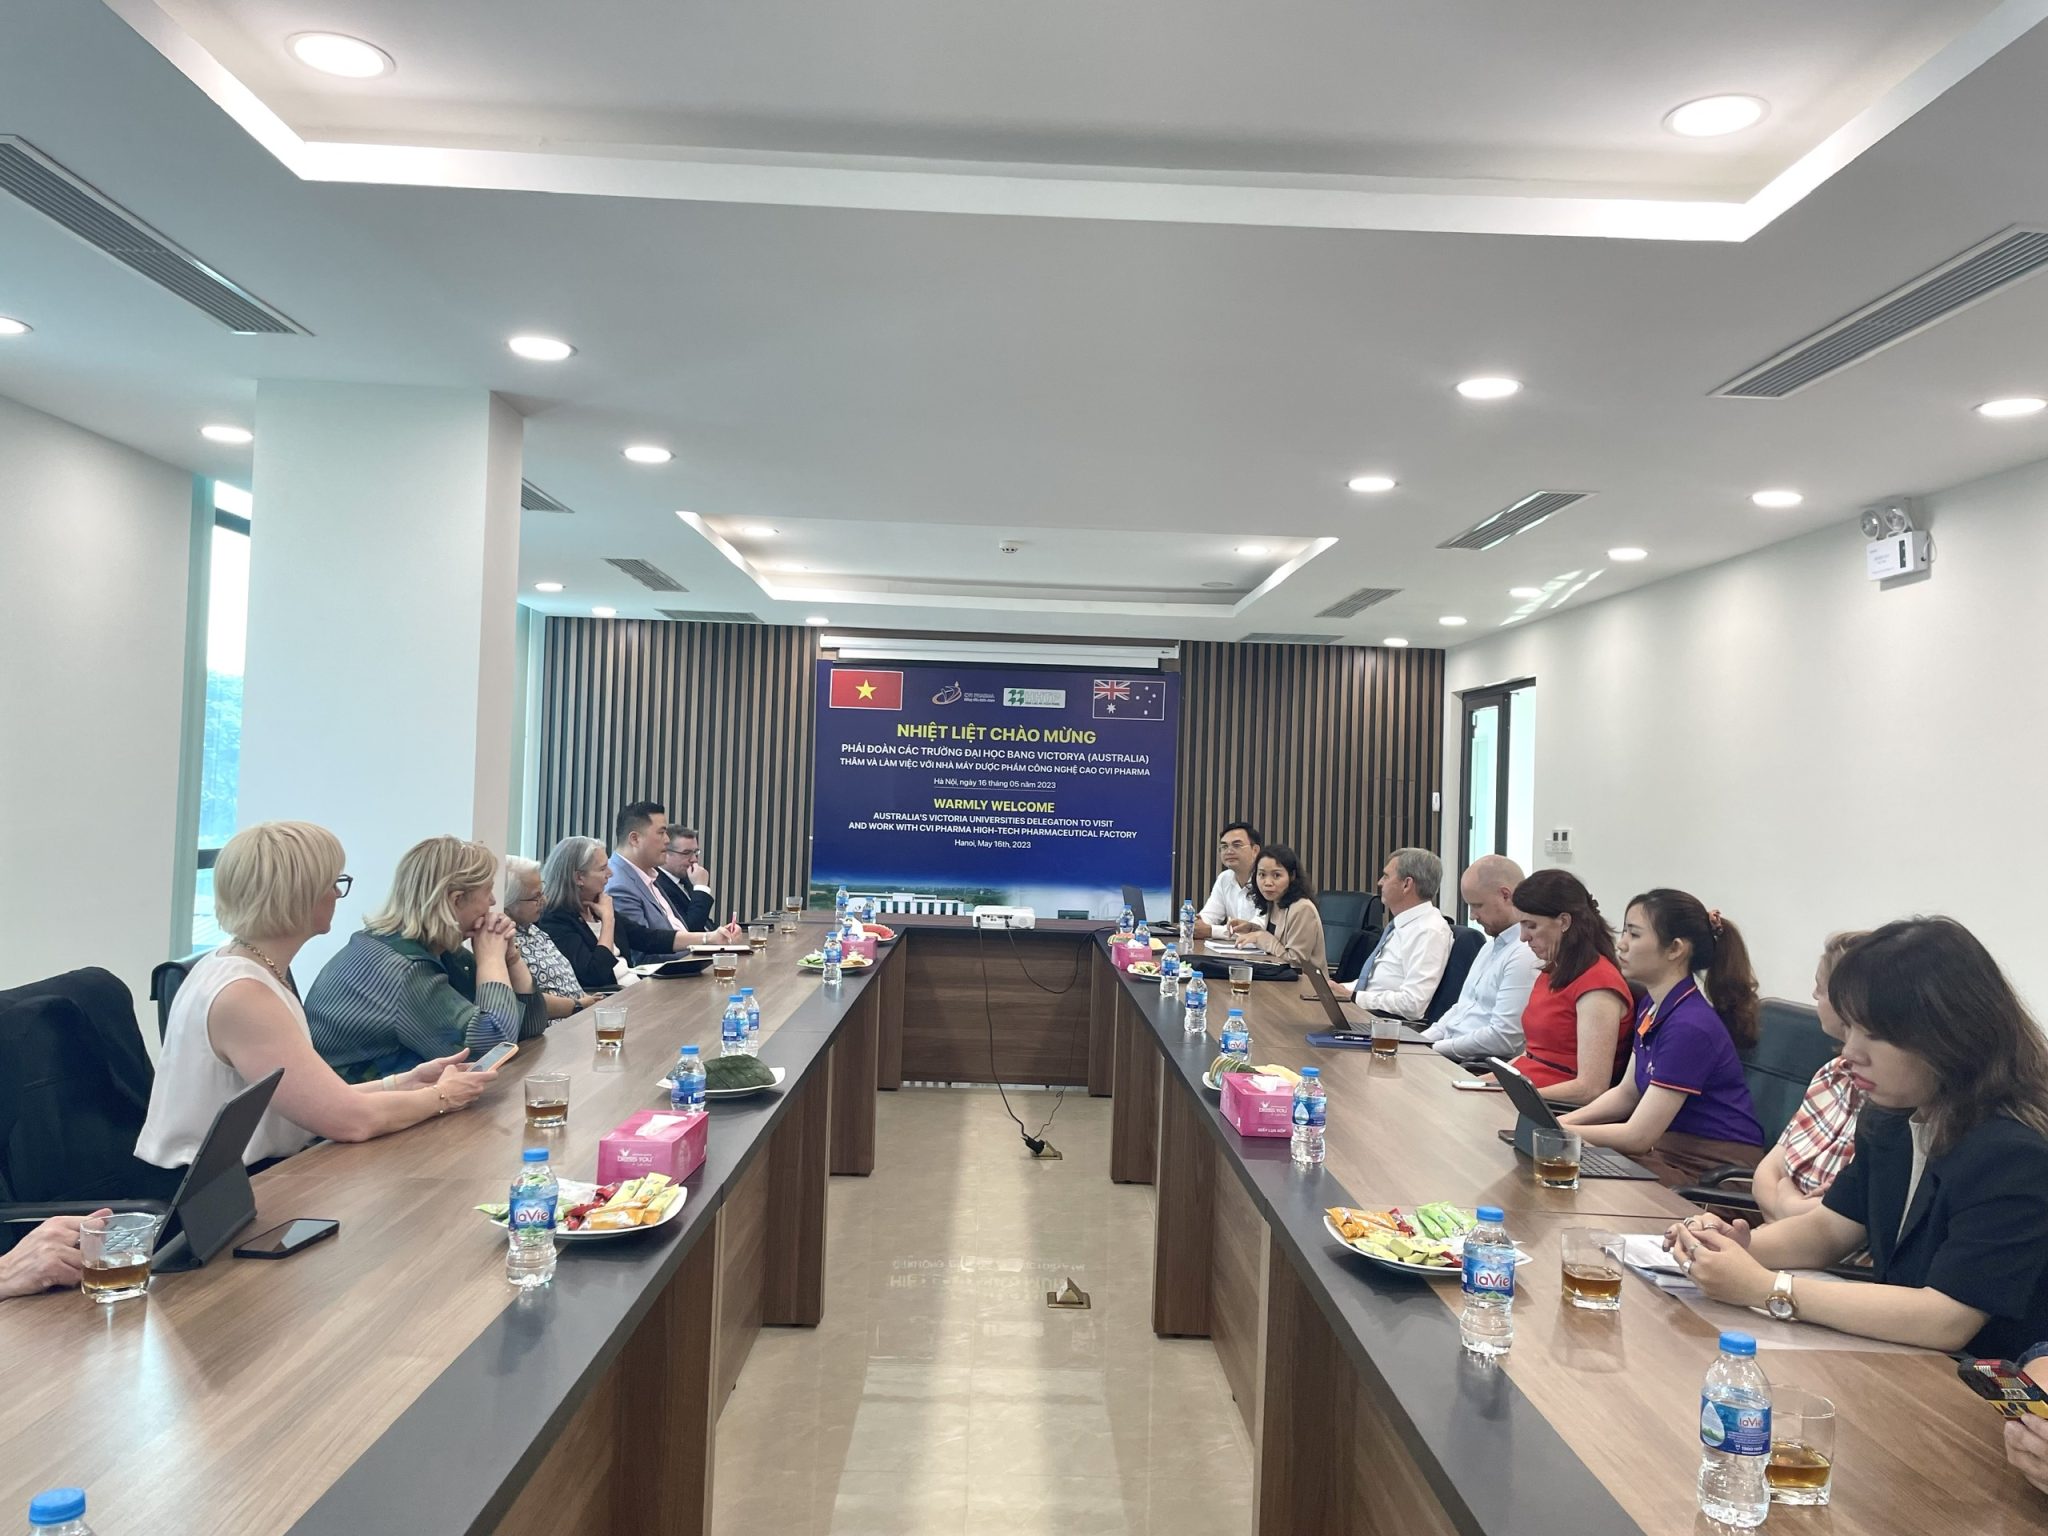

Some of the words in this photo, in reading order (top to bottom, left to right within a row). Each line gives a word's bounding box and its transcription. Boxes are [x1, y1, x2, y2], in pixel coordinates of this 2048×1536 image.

[897, 721, 948, 742] NHIỆT
[951, 722, 987, 743] LIỆT
[990, 724, 1040, 742] CHÀO
[1043, 726, 1097, 744] MỪNG
[841, 742, 866, 753] PHÁI
[867, 743, 896, 754] ĐOÀN
[898, 744, 919, 755] CÁC
[920, 745, 963, 757] TRƯỜNG
[964, 748, 981, 760] ĐẠI
[983, 749, 1006, 760] HỌC
[1007, 750, 1035, 760] BANG
[1037, 751, 1086, 761] VICTORYA
[1087, 753, 1149, 764] (AUSTRALIA)
[866, 757, 878, 767] VÀ
[878, 758, 898, 767] LÀM
[898, 758, 918, 769] VIỆC
[919, 759, 934, 769] VỚI
[935, 760, 954, 769] NHÀ
[955, 761, 974, 770] MÁY
[1027, 762, 1053, 773] CÔNG
[1054, 764, 1078, 775] NGHỆ
[1078, 766, 1098, 774] CAO
[1098, 767, 1113, 775] CVI
[1114, 767, 1151, 776] PHARMA
[933, 777, 944, 785] Hà
[945, 778, 958, 786] Nội,
[959, 778, 977, 787] ngày
[988, 779, 1008, 789] tháng
[1020, 780, 1036, 788] năm
[1037, 781, 1056, 789] 2023
[933, 798, 988, 811] WARMLY
[991, 800, 1055, 813] WELCOME
[873, 812, 928, 821] AUSTRALIA'S
[928, 814, 968, 823] VICTORIA
[969, 815, 1026, 825] UNIVERSITIES
[1026, 817, 1079, 827] DELEGATION
[1080, 819, 1092, 827] TO
[1092, 819, 1114, 828] VISIT
[848, 821, 867, 830] AND
[868, 822, 894, 831] WORK
[895, 823, 918, 832] WITH
[919, 824, 934, 832] CVI
[935, 825, 972, 834] PHARMA
[973, 826, 1020, 835] HIGH-TECH
[1021, 827, 1098, 838] PHARMACEUTICAL
[1099, 830, 1137, 839] FACTORY
[954, 839, 976, 848] Hanoi,
[977, 840, 993, 849] May
[994, 840, 1011, 849] 16th,
[1012, 841, 1032, 849] 2023
[515, 1208, 550, 1222] laVie
[1475, 1272, 1510, 1287] laVie
